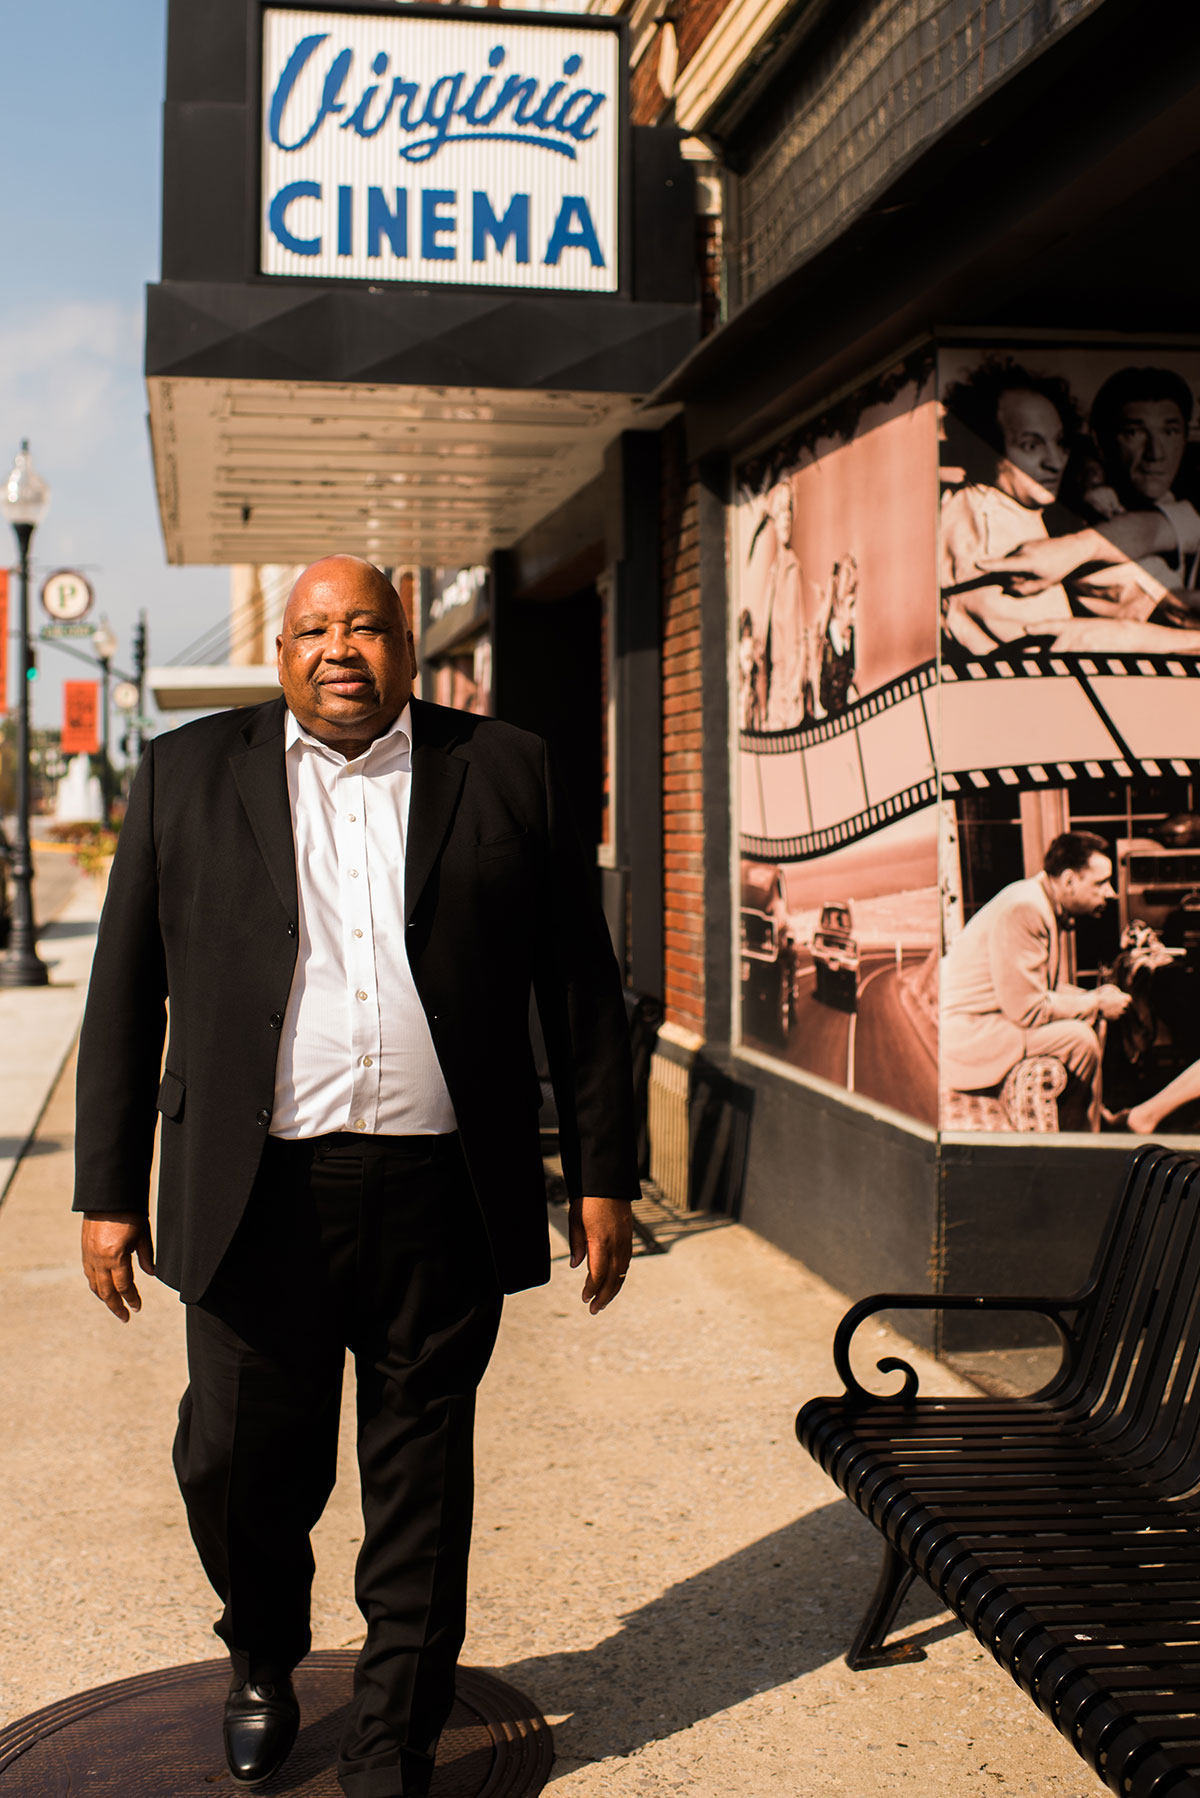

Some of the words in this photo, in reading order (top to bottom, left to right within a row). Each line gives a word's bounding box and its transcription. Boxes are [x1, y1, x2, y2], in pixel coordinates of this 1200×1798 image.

[270, 33, 606, 162] Virginia
[269, 180, 606, 268] CINEMA
[57, 583, 77, 609] P
